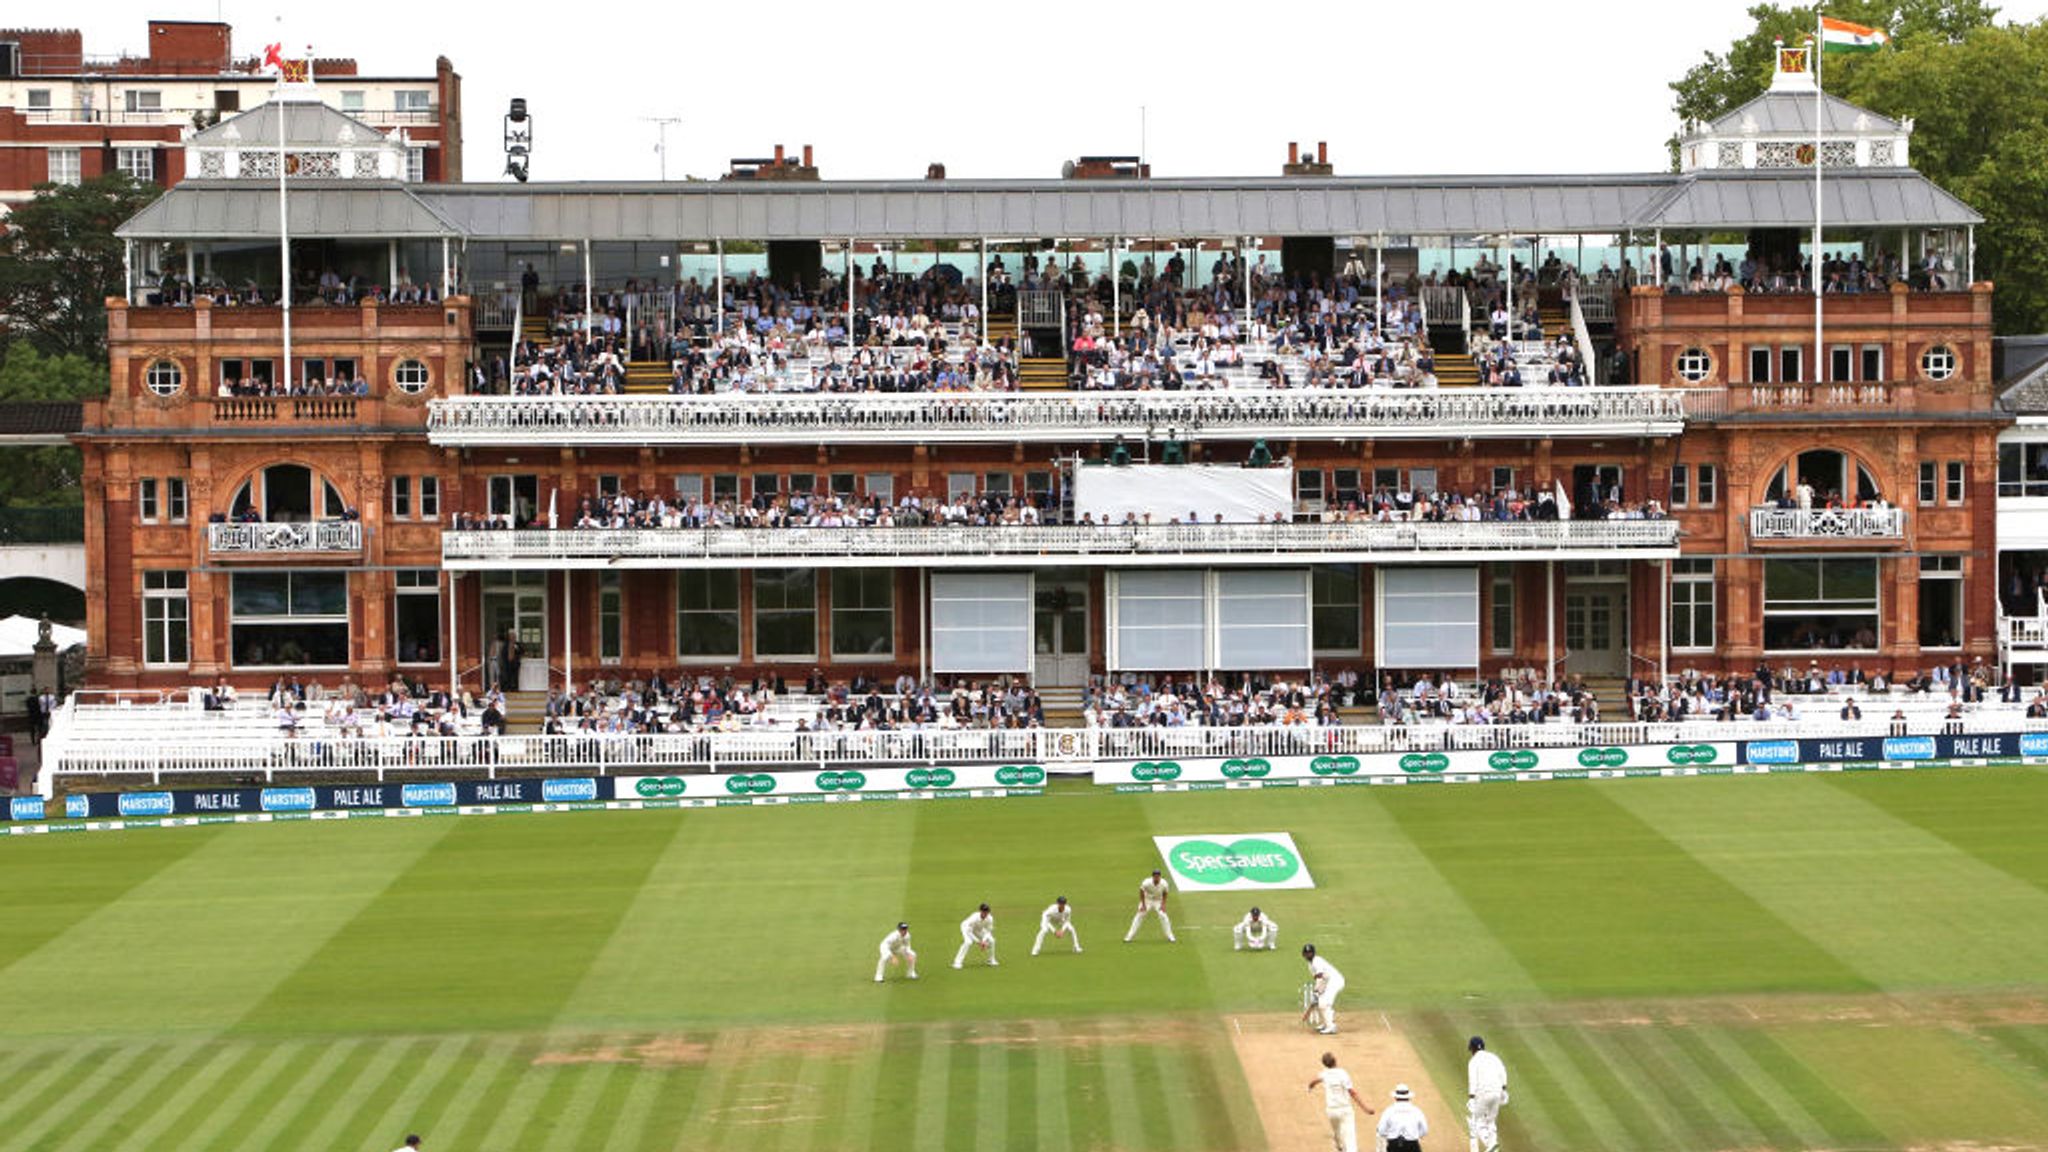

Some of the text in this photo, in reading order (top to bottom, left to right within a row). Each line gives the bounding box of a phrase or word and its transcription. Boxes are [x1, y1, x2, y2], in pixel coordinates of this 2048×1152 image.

[1820, 741, 1864, 758] PALE ALE
[1954, 738, 2001, 755] PALE ALE
[1582, 753, 1623, 762] Specsavers
[1671, 749, 1713, 759] Specsavers
[1314, 760, 1355, 770] Specsavers
[1403, 758, 1445, 767] Specsavers
[1492, 755, 1534, 765] Specsavers
[1136, 766, 1177, 776] Specsavers
[1225, 763, 1267, 773] Specsavers
[910, 773, 951, 783] Specsavers
[999, 771, 1040, 780] Specsavers
[639, 781, 681, 791] Specsavers
[729, 779, 771, 788] Specsavers
[819, 776, 861, 786] Specsavers
[334, 788, 382, 805] PALE ALE
[476, 784, 522, 800] PALE ALE
[195, 793, 241, 809] PALE ALE
[1179, 851, 1287, 873] Specsavers
